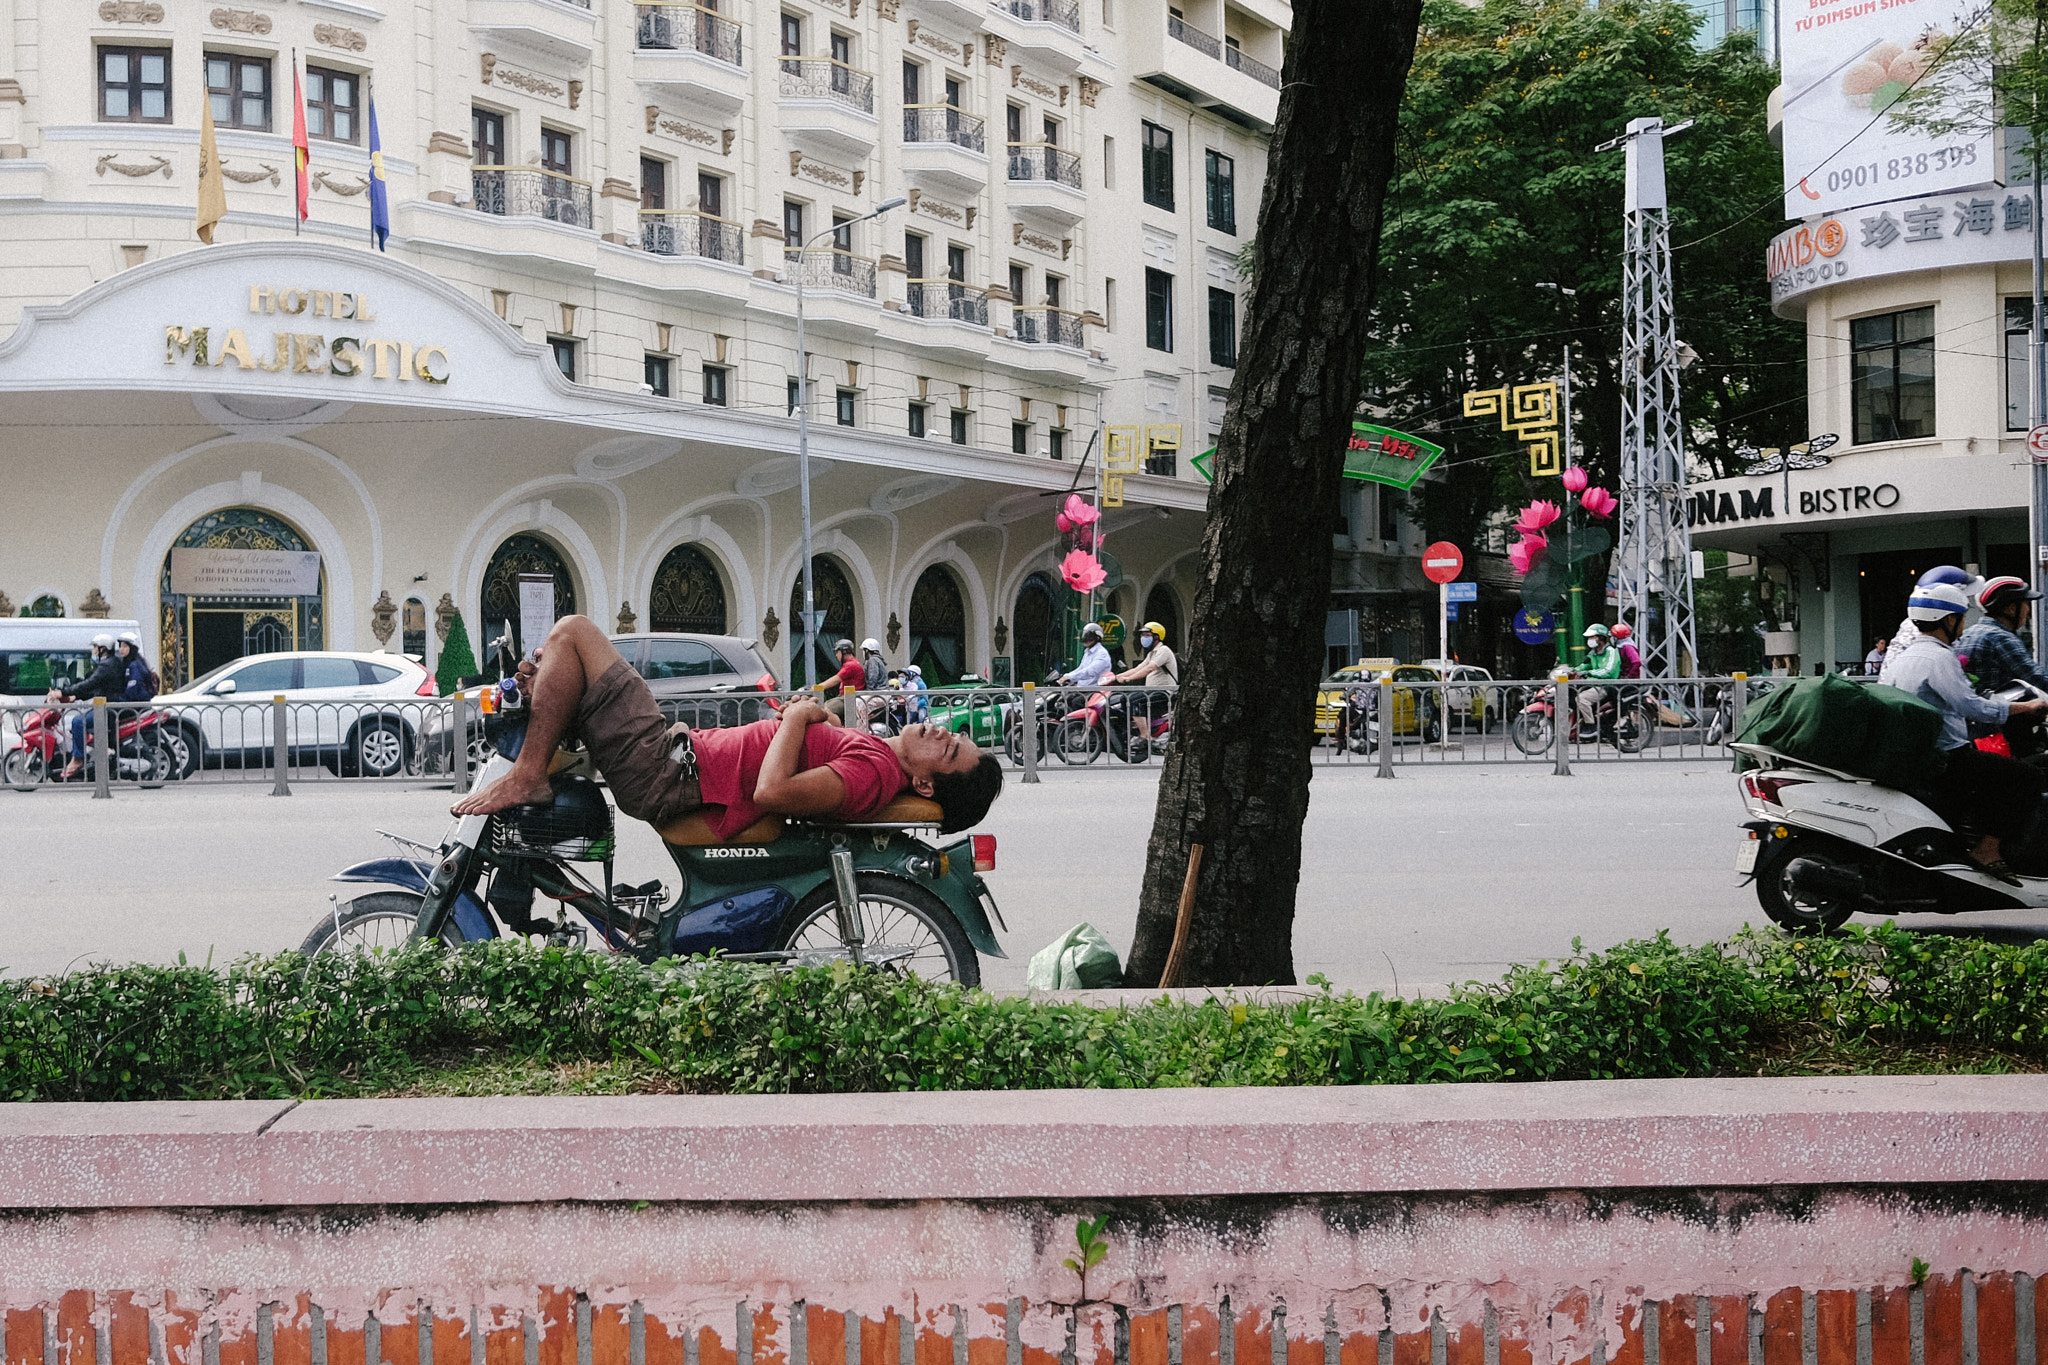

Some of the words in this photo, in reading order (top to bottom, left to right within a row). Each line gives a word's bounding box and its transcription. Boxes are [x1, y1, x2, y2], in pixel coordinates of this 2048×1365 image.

[1817, 1, 1877, 27] DIMSUM
[1828, 162, 1880, 192] 0901
[1887, 152, 1929, 181] 838
[248, 284, 377, 322] HOTEL
[163, 325, 451, 386] MAJESTIC
[1800, 483, 1900, 514] BISTRO
[704, 847, 770, 859] HONDA
